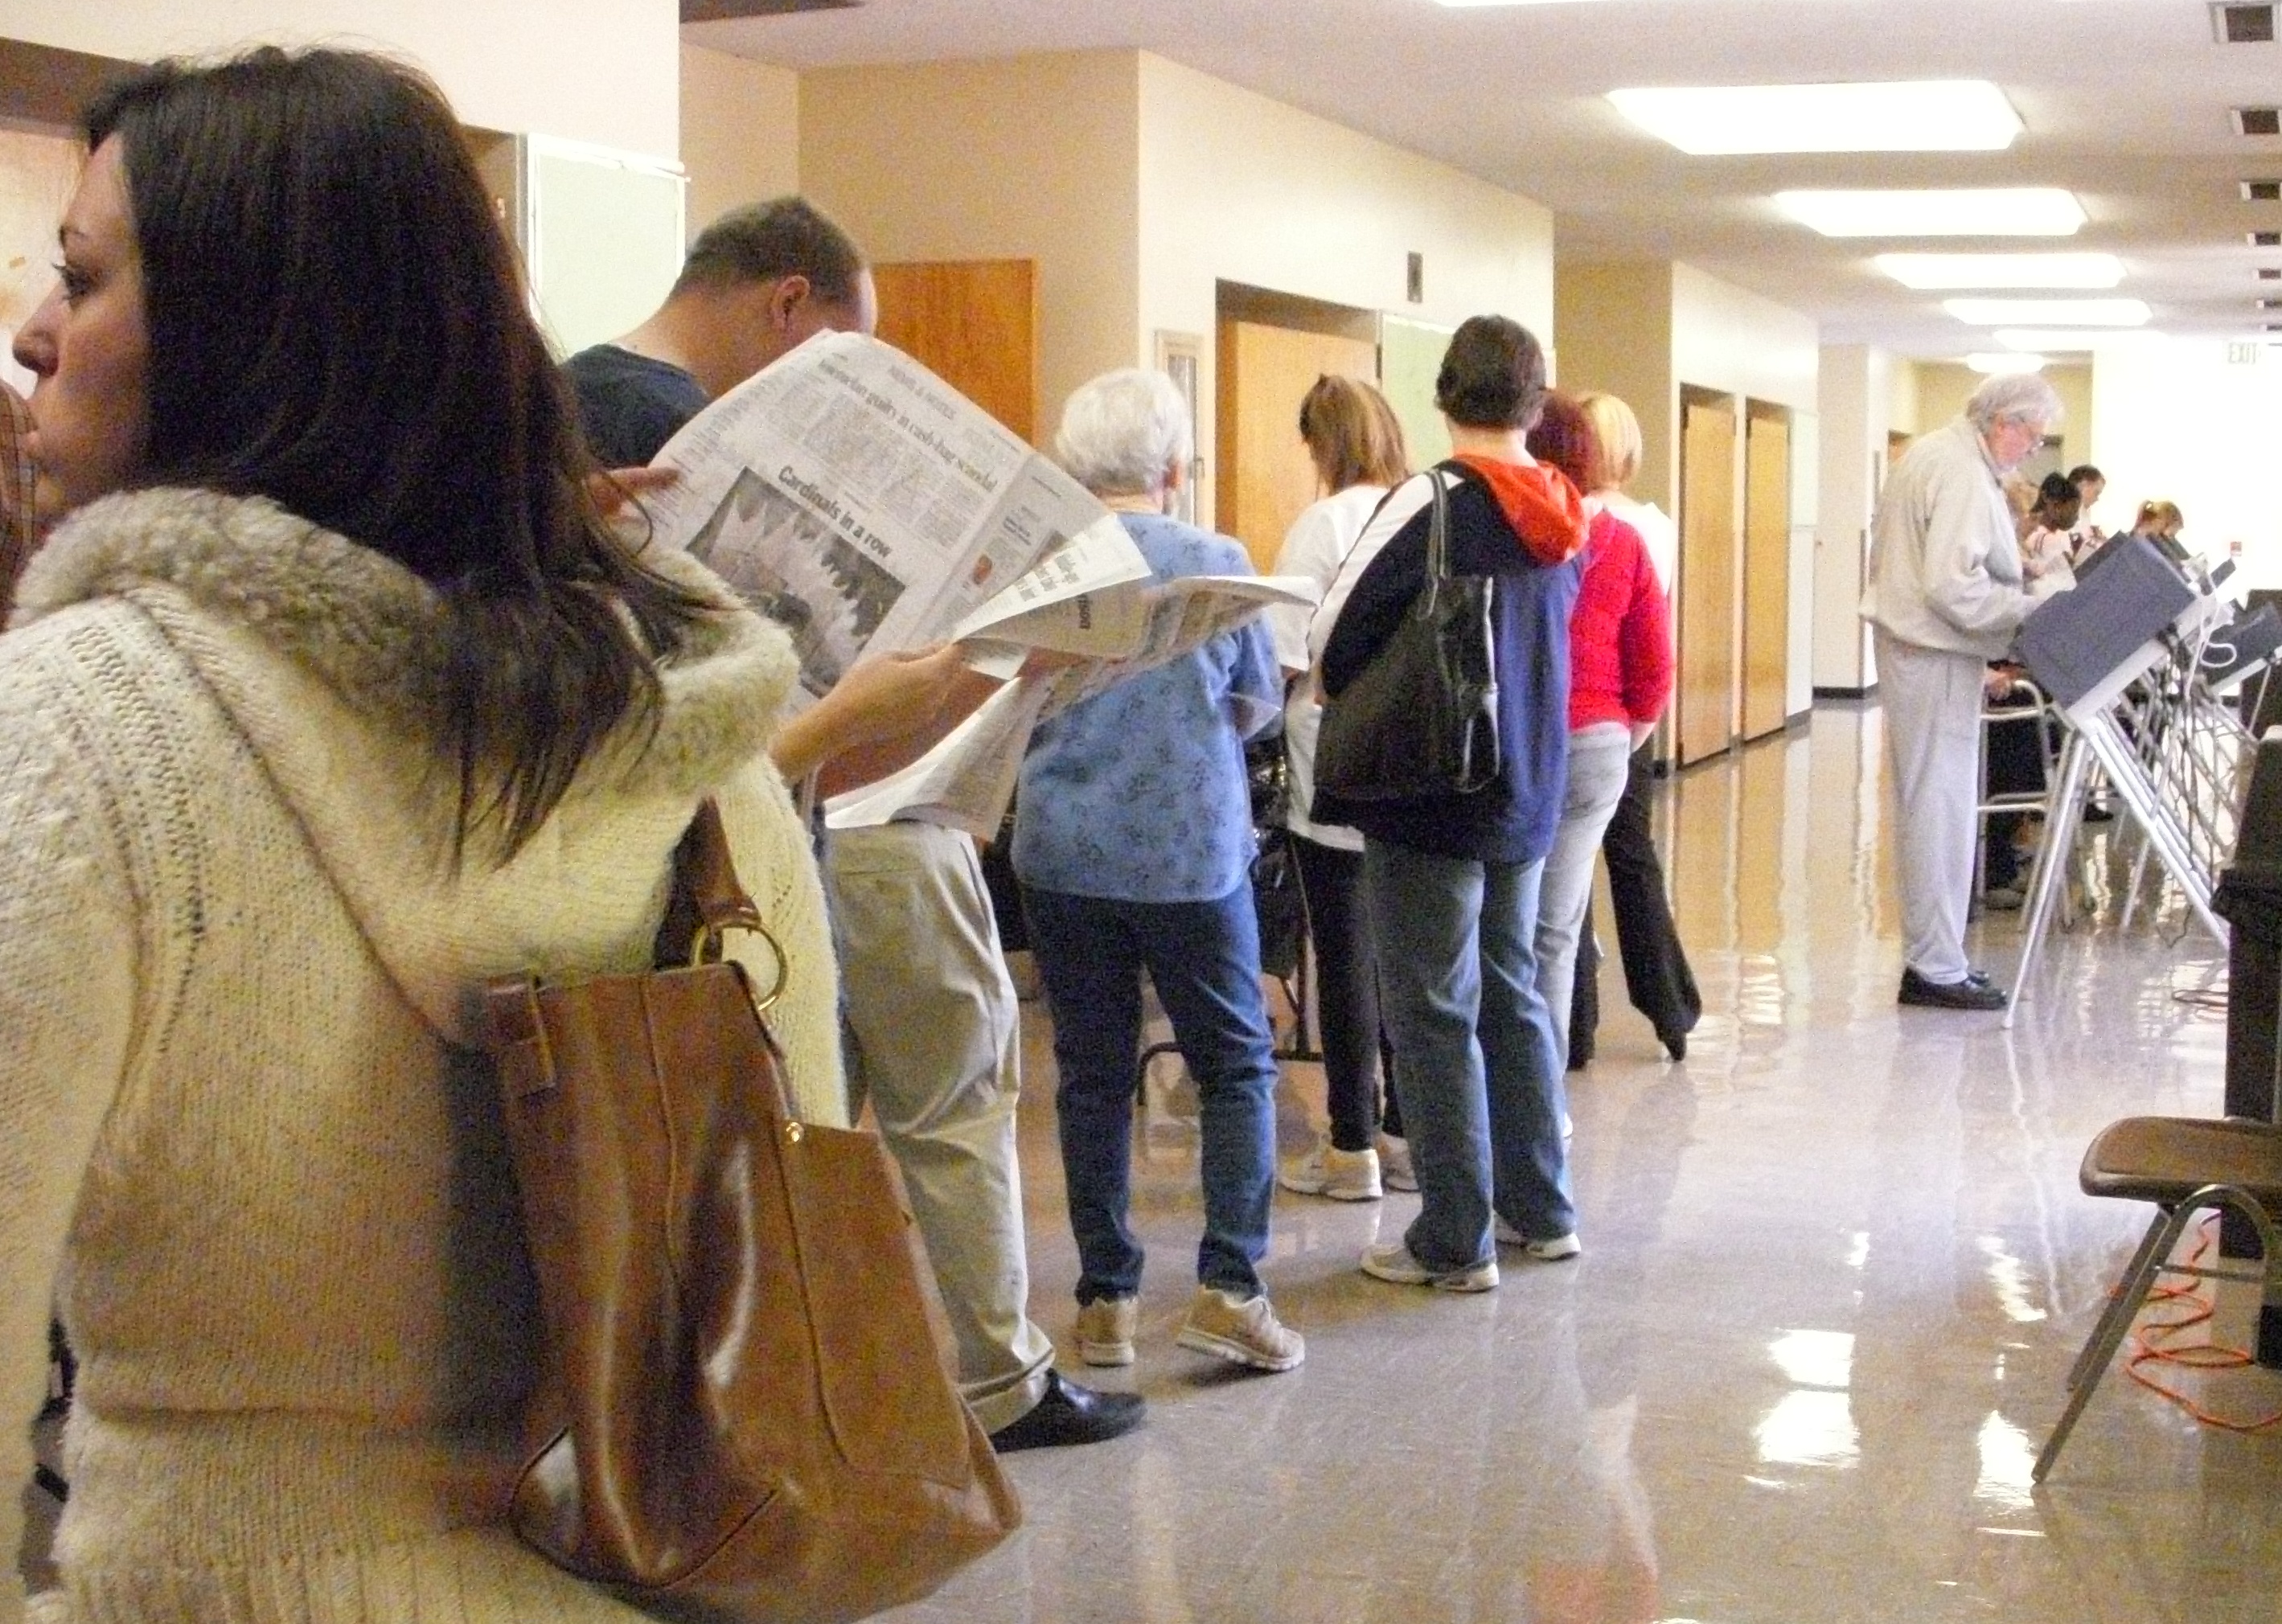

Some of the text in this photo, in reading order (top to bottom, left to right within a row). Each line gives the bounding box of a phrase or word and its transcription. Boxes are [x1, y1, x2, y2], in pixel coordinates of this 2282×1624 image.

[2228, 342, 2257, 364] EXIT
[778, 465, 842, 520] Cardinals
[839, 511, 855, 531] in
[852, 525, 865, 538] a
[864, 533, 893, 558] row
